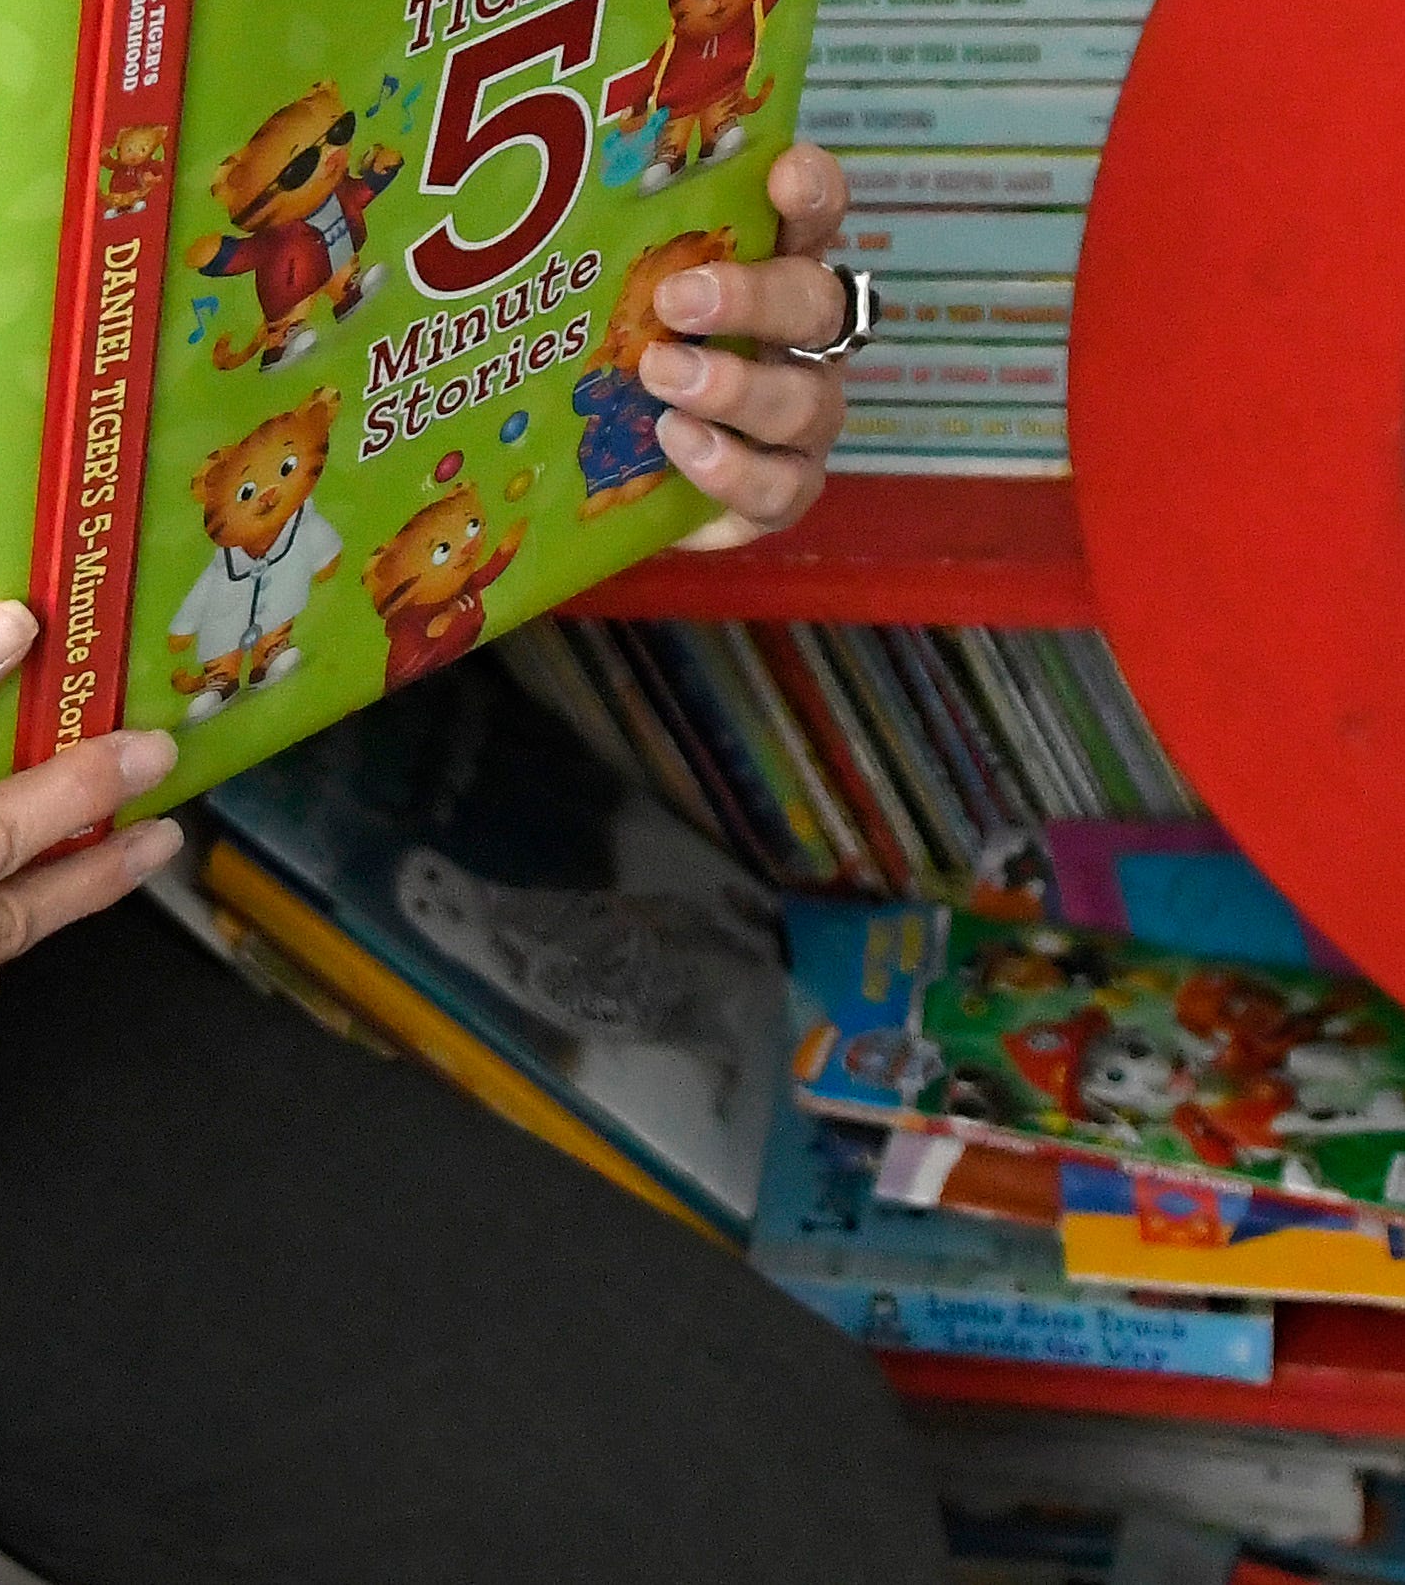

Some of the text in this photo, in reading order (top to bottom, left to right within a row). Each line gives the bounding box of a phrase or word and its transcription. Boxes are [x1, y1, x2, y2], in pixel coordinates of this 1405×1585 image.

[143, 5, 166, 87] TIGER'S
[95, 237, 142, 376] DANIEL
[366, 249, 602, 397] Minute
[80, 377, 128, 509] TIGER'S
[360, 311, 592, 460] Stories
[65, 512, 114, 665] 5-Minute
